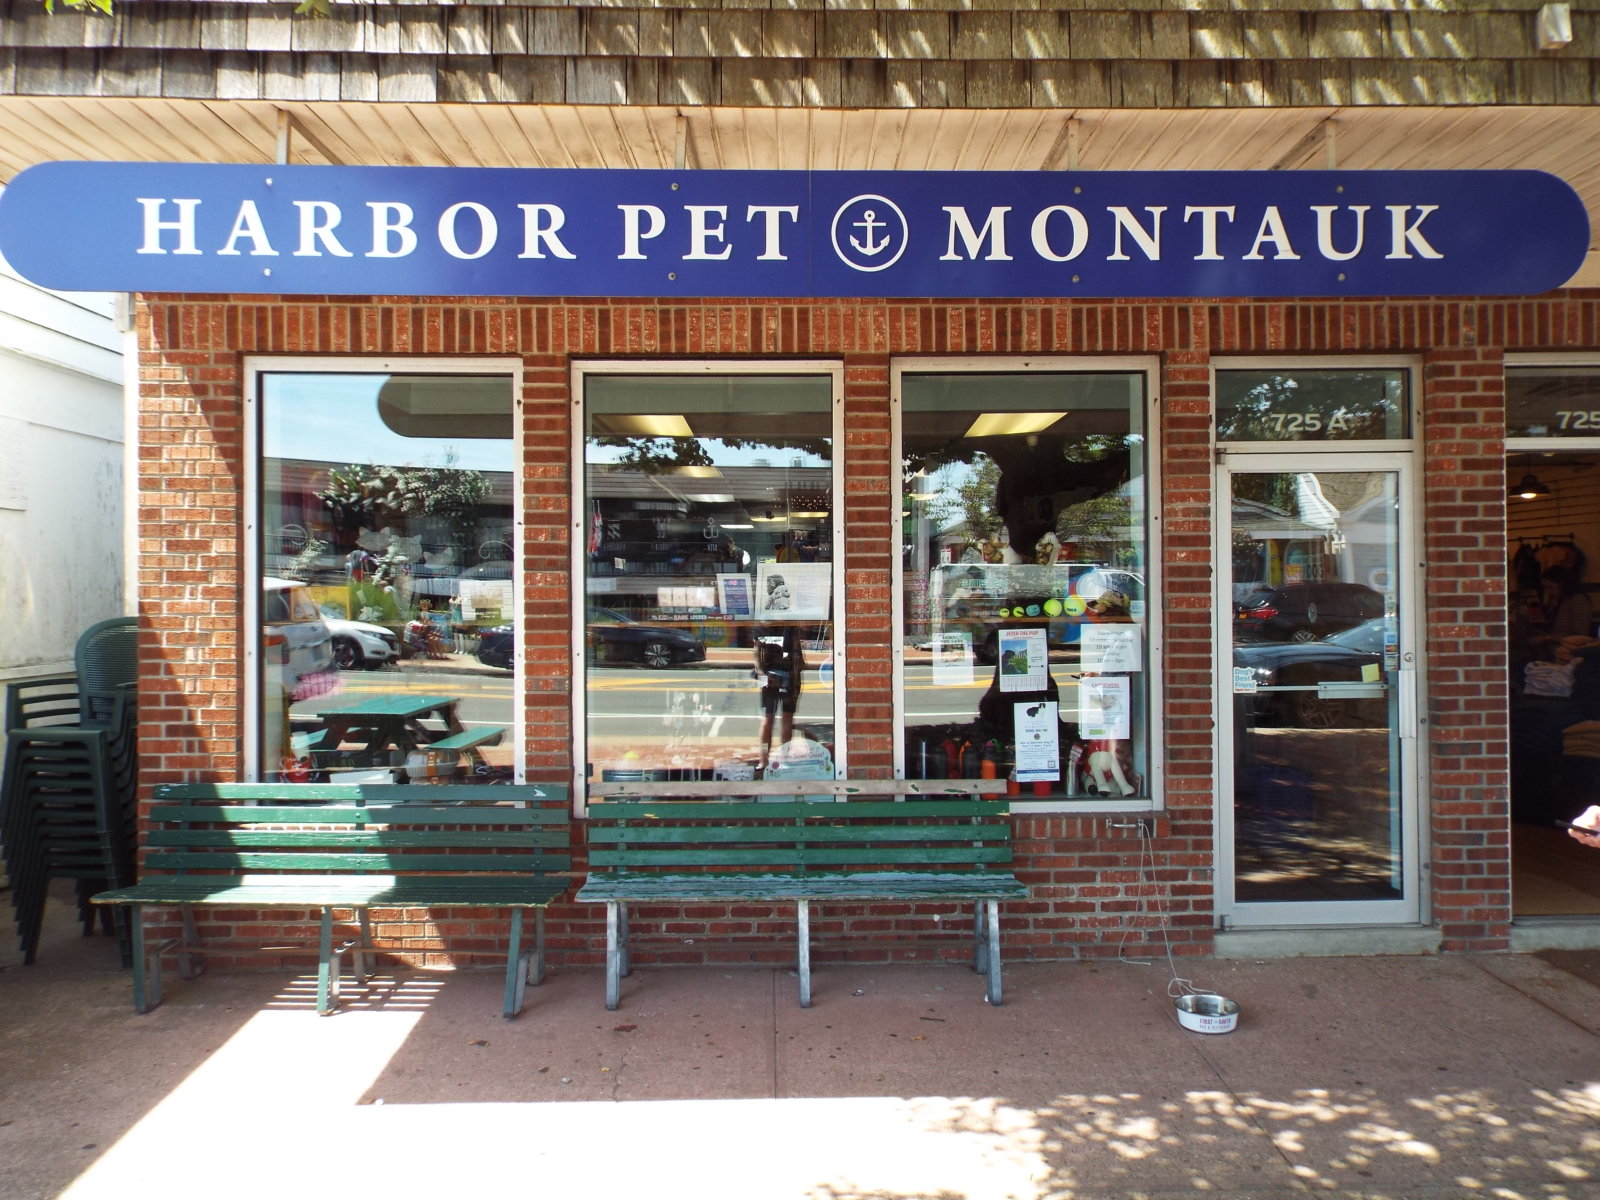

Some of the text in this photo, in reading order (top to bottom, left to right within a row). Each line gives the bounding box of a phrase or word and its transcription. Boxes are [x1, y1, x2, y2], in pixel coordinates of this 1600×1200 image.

[136, 197, 1444, 262] HARBOR PET MONTAUK
[1271, 413, 1348, 431] 725 A
[1556, 411, 1600, 429] 725
